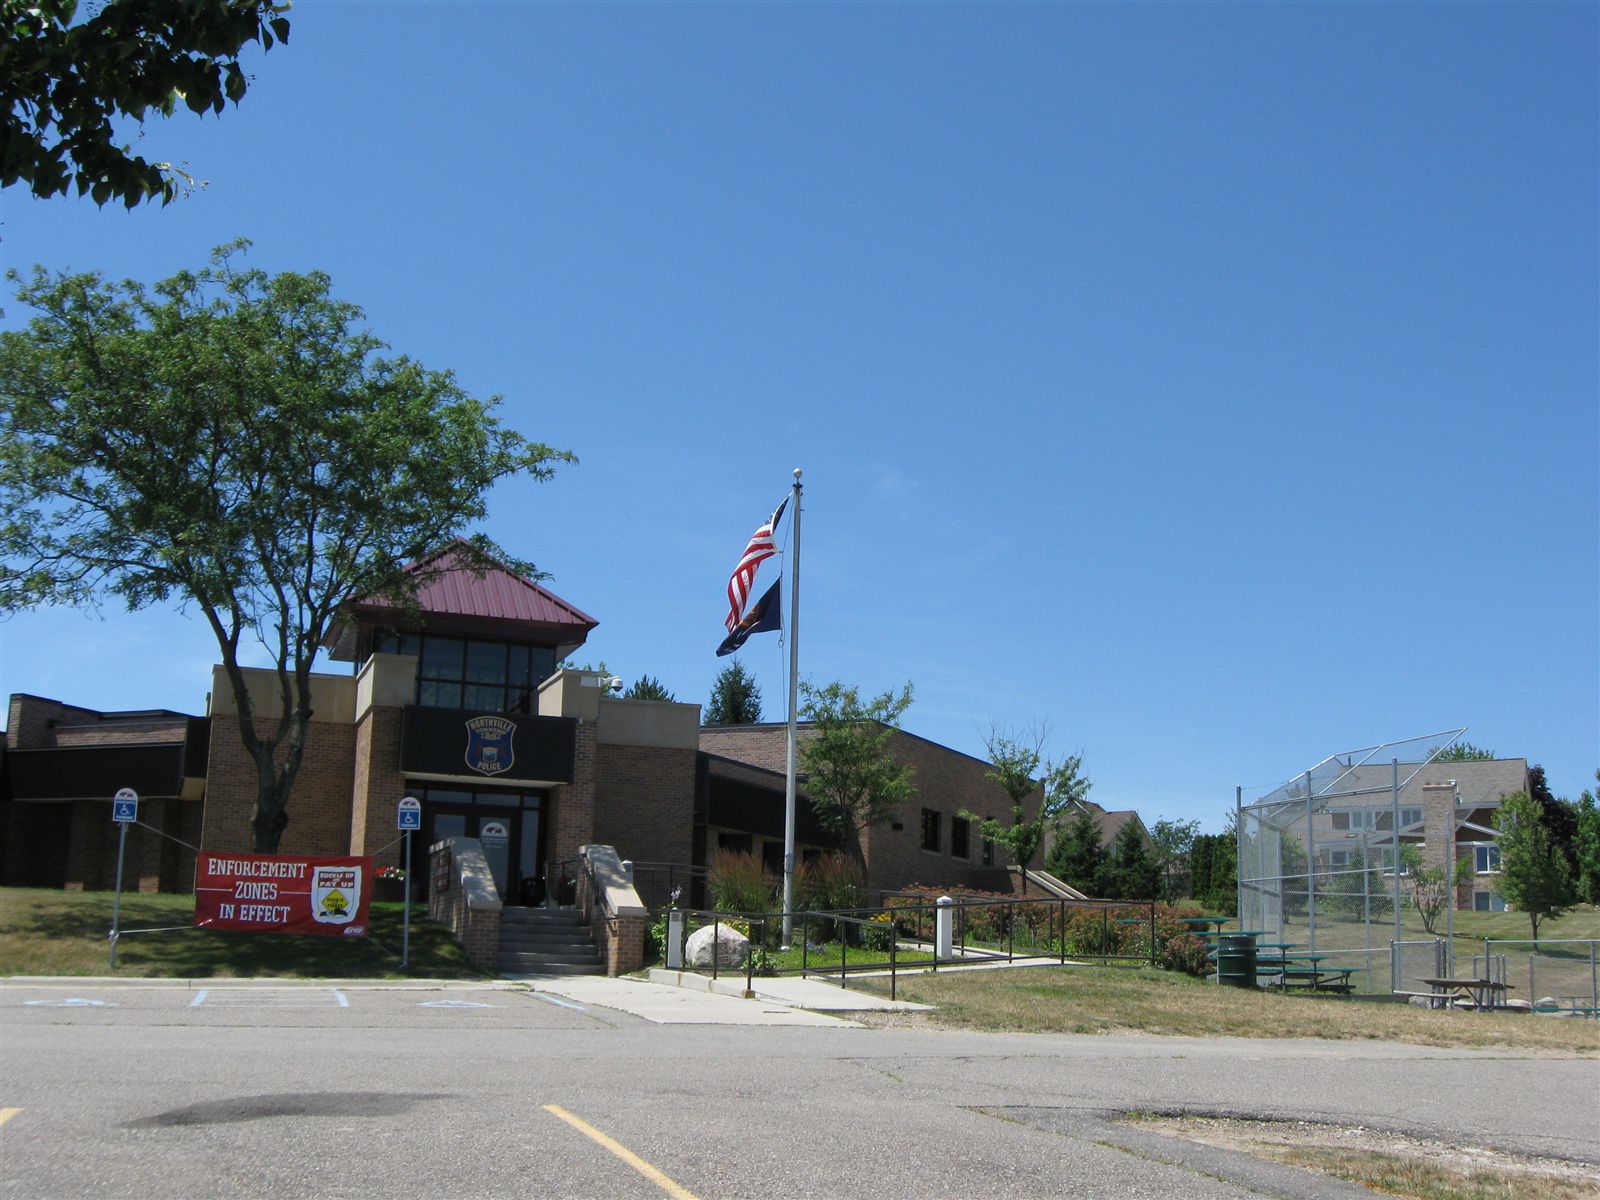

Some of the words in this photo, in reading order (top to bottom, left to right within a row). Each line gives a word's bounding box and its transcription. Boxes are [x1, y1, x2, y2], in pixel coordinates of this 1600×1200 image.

[470, 719, 512, 732] NORTHVILLE
[478, 761, 501, 770] POLICE
[208, 858, 307, 878] ENFORCEMENT
[235, 881, 278, 900] ZONES
[219, 903, 235, 919] IN
[240, 905, 290, 923] EFFECT
